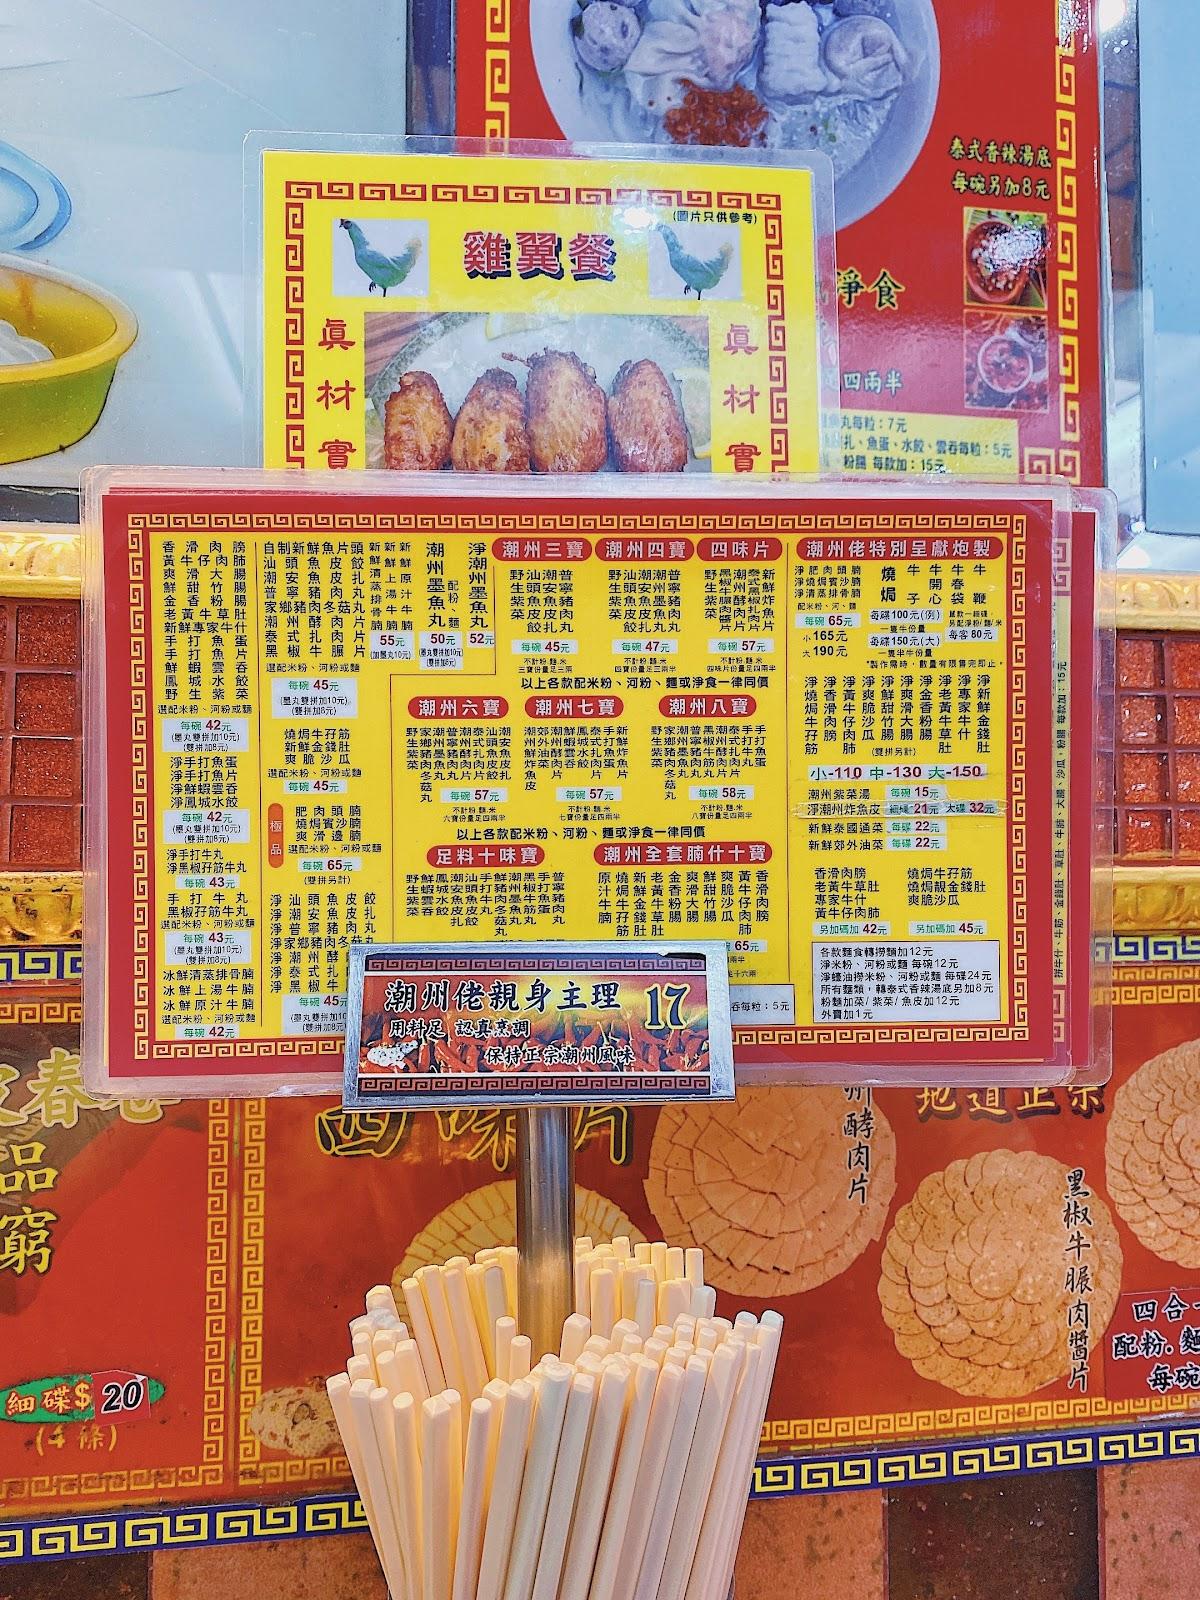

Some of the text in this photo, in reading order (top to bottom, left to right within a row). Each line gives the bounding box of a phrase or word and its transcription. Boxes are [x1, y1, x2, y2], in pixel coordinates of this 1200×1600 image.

[949, 137, 1052, 169] 泰式香辣湯底
[952, 171, 1050, 200] 每碗另加8元
[463, 231, 616, 281] 雞翼餐
[264, 541, 364, 555] 自制新鮮魚片頭
[502, 541, 584, 558] 潮州三寶
[605, 541, 686, 559] 潮州四寶
[711, 541, 770, 558] 四味片
[807, 540, 990, 558] 潮州佬特別呈獻炮製
[163, 554, 246, 567] 黃牛仔肉肺
[264, 556, 364, 569] 汕頭魚皮餃
[163, 568, 246, 580] 爽滑大腸
[264, 571, 365, 585] 潮安魚皮扎
[426, 543, 446, 628] 潮州墨魚丸
[468, 543, 489, 628] 淨潮州墨魚丸
[264, 586, 365, 599] 普寧豬肉丸
[163, 595, 247, 607] 金香粉腸
[264, 601, 366, 614] 家鄉豬肉冬菇丸
[164, 608, 247, 620] 老黃牛草肚
[805, 616, 852, 626] 每碗 65元
[164, 622, 248, 634] 新鮮專家牛什
[165, 635, 248, 647] 手打魚蛋
[265, 630, 366, 643] 泰式扎肉片
[380, 635, 405, 647] 55元
[430, 633, 456, 646] 50元
[469, 633, 495, 645] 52元
[622, 641, 670, 653] 每碗 47元
[165, 662, 248, 674] 鮮蝦雲吞
[165, 675, 248, 687] 鳳城水餃
[288, 679, 340, 692] 每碗 45元
[165, 688, 249, 700] 野生紫菜
[419, 699, 500, 716] 潮州六寶
[535, 699, 615, 716] 潮州七寶
[669, 698, 748, 715] 潮州八寶
[180, 719, 232, 732] 每碗 42元
[285, 742, 350, 753] 新鮮金錢肚
[170, 756, 238, 769] 淨手打魚蛋
[170, 783, 238, 795] 淨鮮蝦雲吞
[565, 789, 614, 800] 每碗 57元
[698, 788, 746, 799] 每碗 58元
[808, 789, 870, 800] 潮州紫菜湯
[915, 787, 940, 799] 15元
[295, 805, 362, 817] 肥肉頭腩
[969, 803, 994, 814] 32元
[182, 811, 233, 823] 每碗 42元
[809, 822, 884, 834] 新鮮泰國通菜
[915, 821, 940, 833] 22元
[270, 820, 282, 855] 極品
[809, 839, 884, 851] 新鮮郊外油菜
[915, 838, 940, 849] 22元
[166, 848, 224, 861] 淨手打牛丸
[436, 847, 538, 865] 足料十味寶
[604, 845, 766, 863] 潮州全套腩什十寶
[302, 860, 353, 871] 每碗 65元
[815, 881, 880, 893] 老黃牛草肚
[167, 892, 248, 905] 手打牛丸
[270, 892, 376, 906] 淨汕頭魚皮餃
[815, 894, 866, 906] 專家牛什
[908, 894, 960, 906] 爽脆沙瓜
[815, 907, 880, 919] 黃牛仔肉肺
[863, 923, 888, 935] 42元
[959, 923, 984, 934] 45元
[163, 983, 254, 996] 冰鮮上湯牛腩
[163, 998, 254, 1011] 冰鮮原汁牛腩
[384, 979, 690, 1030] 潮州佬親身主理 17
[389, 1018, 446, 1039] 用料足
[486, 1046, 636, 1065] 保持正宗潮州風味
